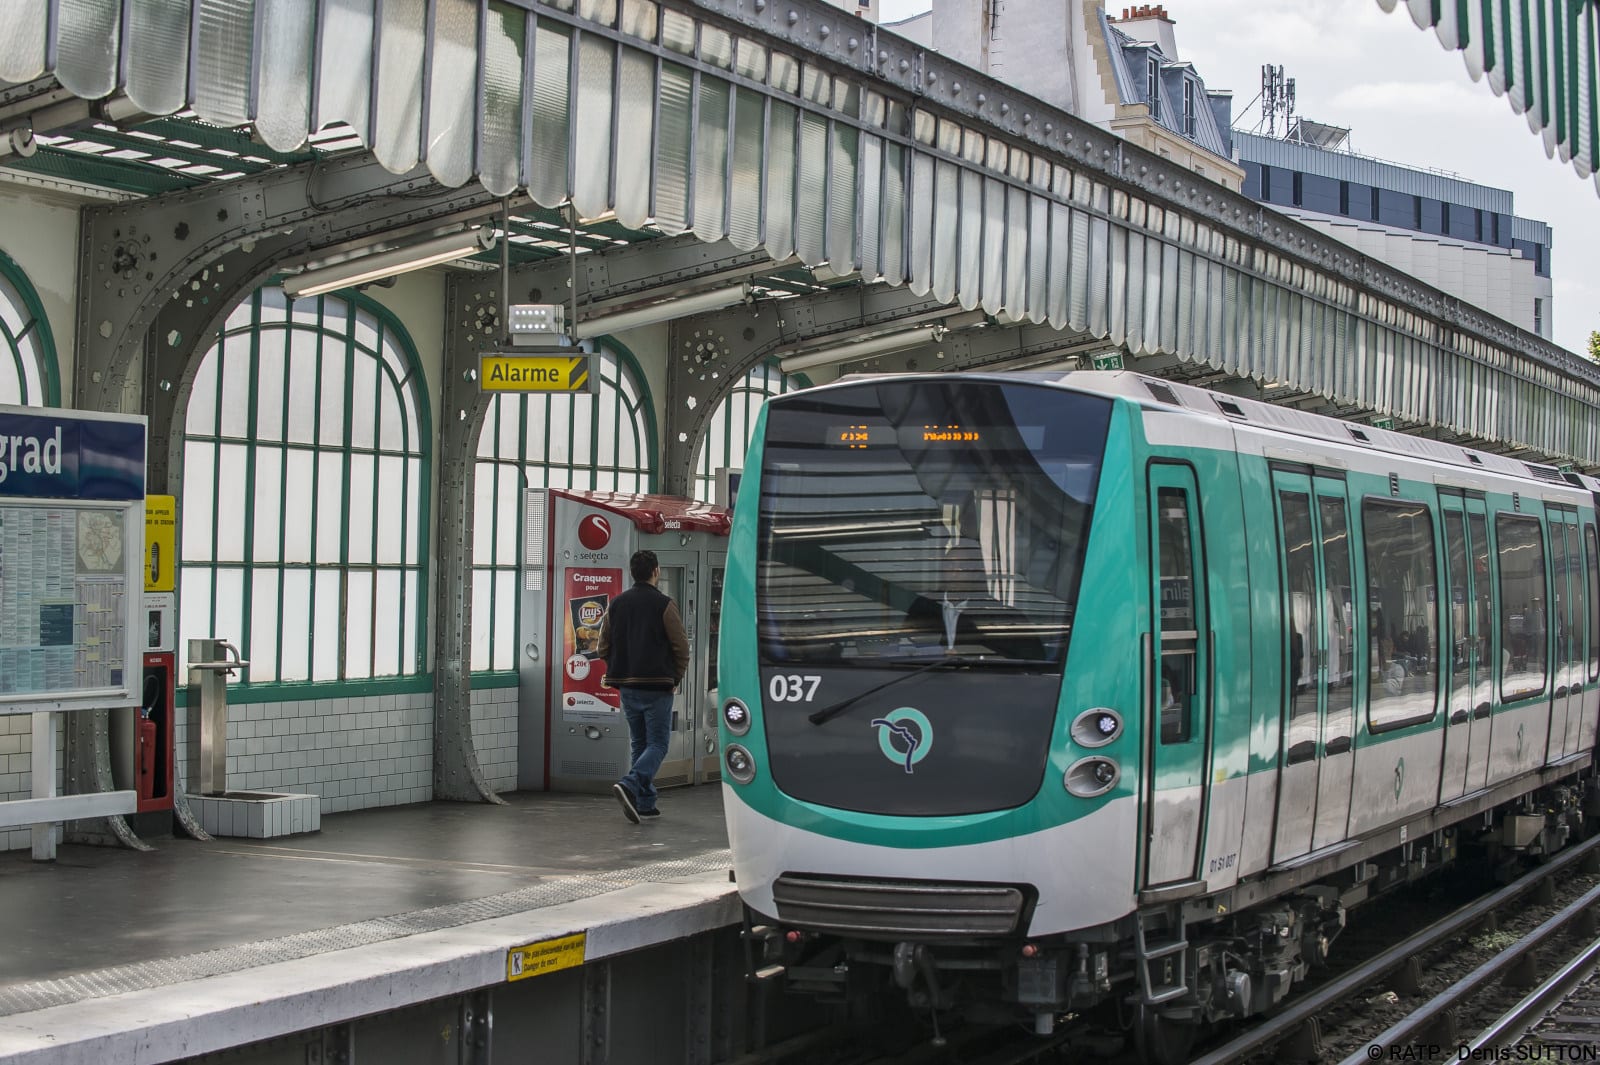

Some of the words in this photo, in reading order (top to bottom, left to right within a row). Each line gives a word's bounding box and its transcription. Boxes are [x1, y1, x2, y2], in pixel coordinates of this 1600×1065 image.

[490, 363, 559, 382] Alarme
[664, 519, 681, 529] selecta
[580, 552, 609, 560] selecta
[573, 573, 613, 584] Craquez
[769, 674, 822, 702] 037
